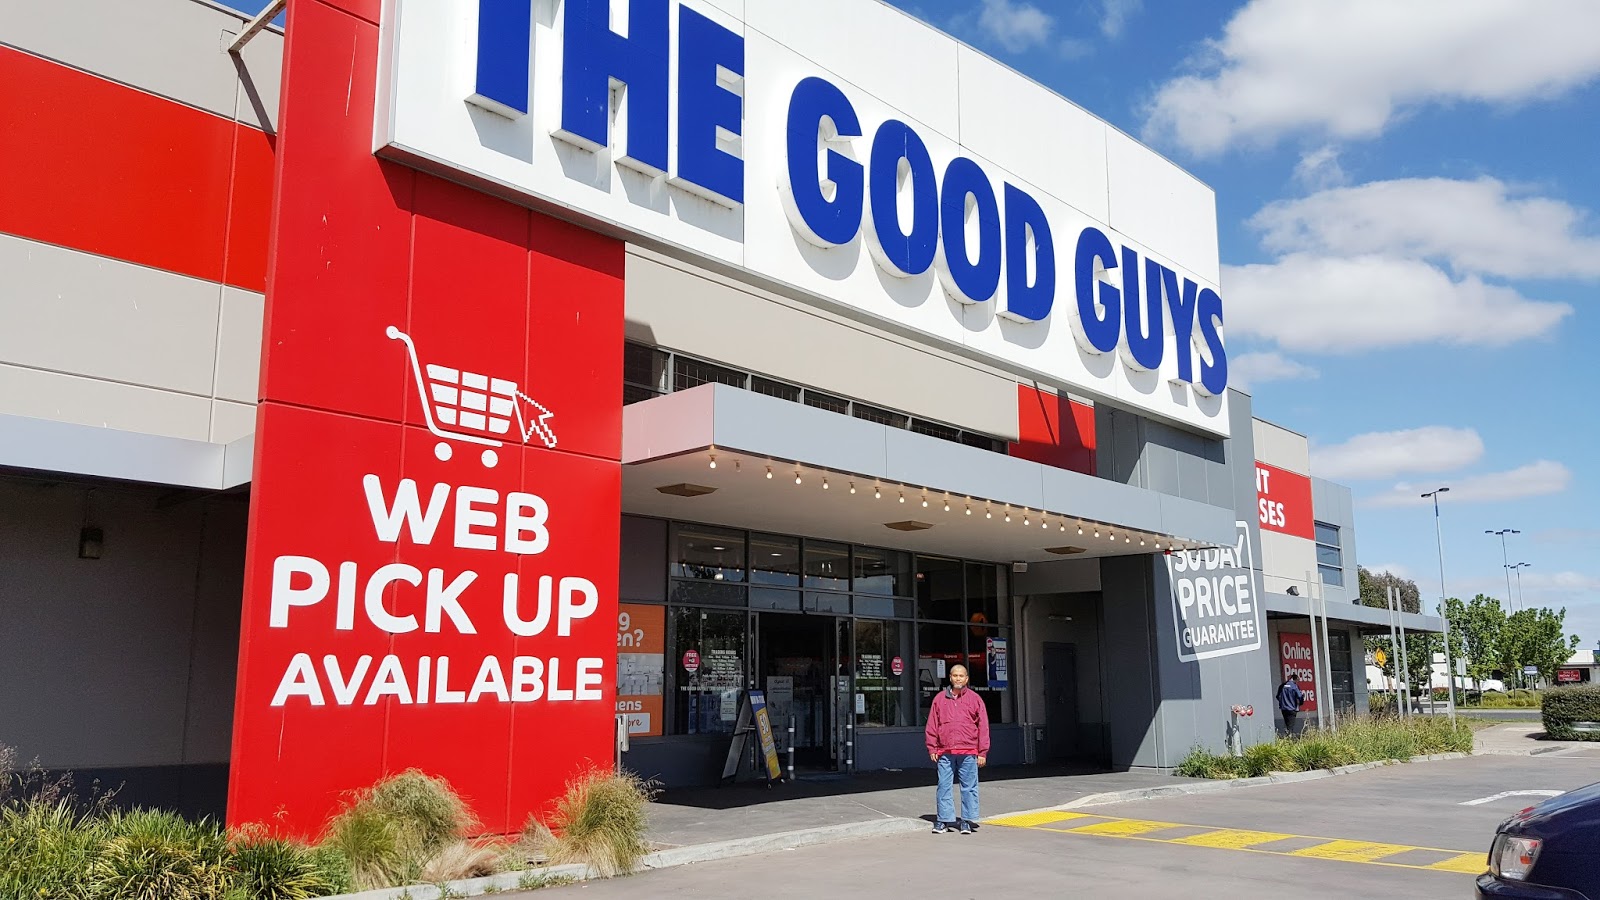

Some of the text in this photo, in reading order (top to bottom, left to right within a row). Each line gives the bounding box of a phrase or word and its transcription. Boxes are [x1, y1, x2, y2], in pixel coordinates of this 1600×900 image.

[787, 76, 1056, 321] GOOD
[1075, 227, 1228, 395] GUYS
[363, 473, 550, 554] WEB
[1204, 534, 1244, 570] DAY
[269, 555, 599, 636] PICK UP
[1178, 575, 1251, 620] PRICE
[1183, 620, 1255, 648] GUARANTEE
[1283, 642, 1311, 660] Online
[270, 653, 603, 706] AVAILABLE
